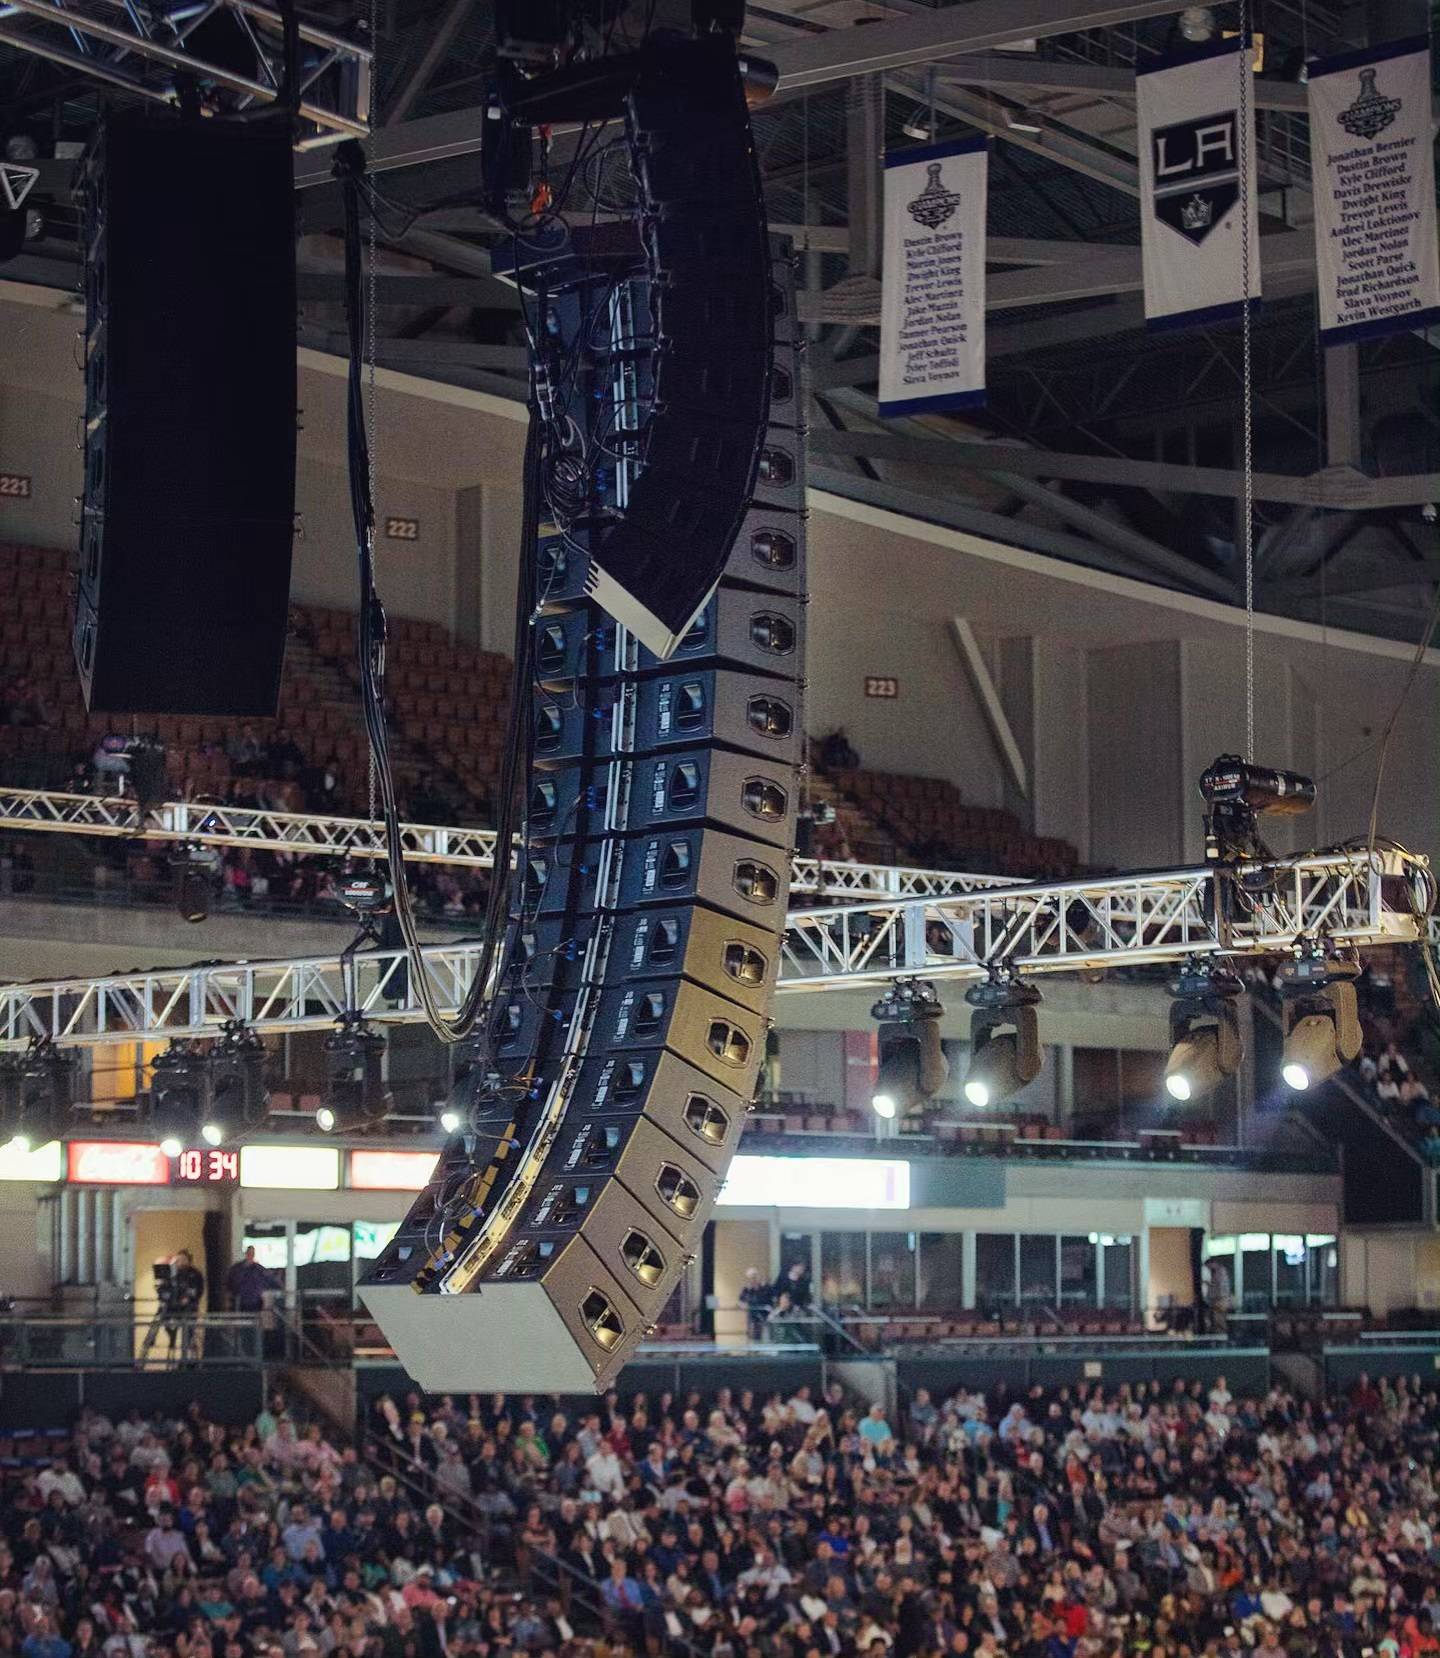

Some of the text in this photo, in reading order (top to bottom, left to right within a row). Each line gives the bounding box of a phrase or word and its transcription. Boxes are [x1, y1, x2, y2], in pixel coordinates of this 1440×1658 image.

[1155, 122, 1234, 176] LA
[1326, 137, 1416, 167] Jonathan Bernier
[1337, 152, 1407, 174] Dustin Brown
[1340, 162, 1406, 187] Kyle Clifford
[1333, 187, 1361, 200] Davis
[1342, 188, 1406, 211] Dwight King
[1340, 201, 1409, 223] Trevor Lewis
[1342, 226, 1409, 248] Alec Martinez
[1343, 239, 1409, 262] Jordan Nolan
[1337, 260, 1417, 286] Jonathan Quick
[1348, 253, 1404, 271] Scott Parse
[1336, 274, 1420, 299] Brad Richardson
[1344, 288, 1412, 310] Slava Voynov
[1337, 310, 1367, 324] Kevin
[0, 476, 29, 496] 221
[389, 521, 416, 538] 222
[868, 680, 896, 696] 223
[179, 1150, 202, 1180] 10
[208, 1150, 238, 1180] 34
